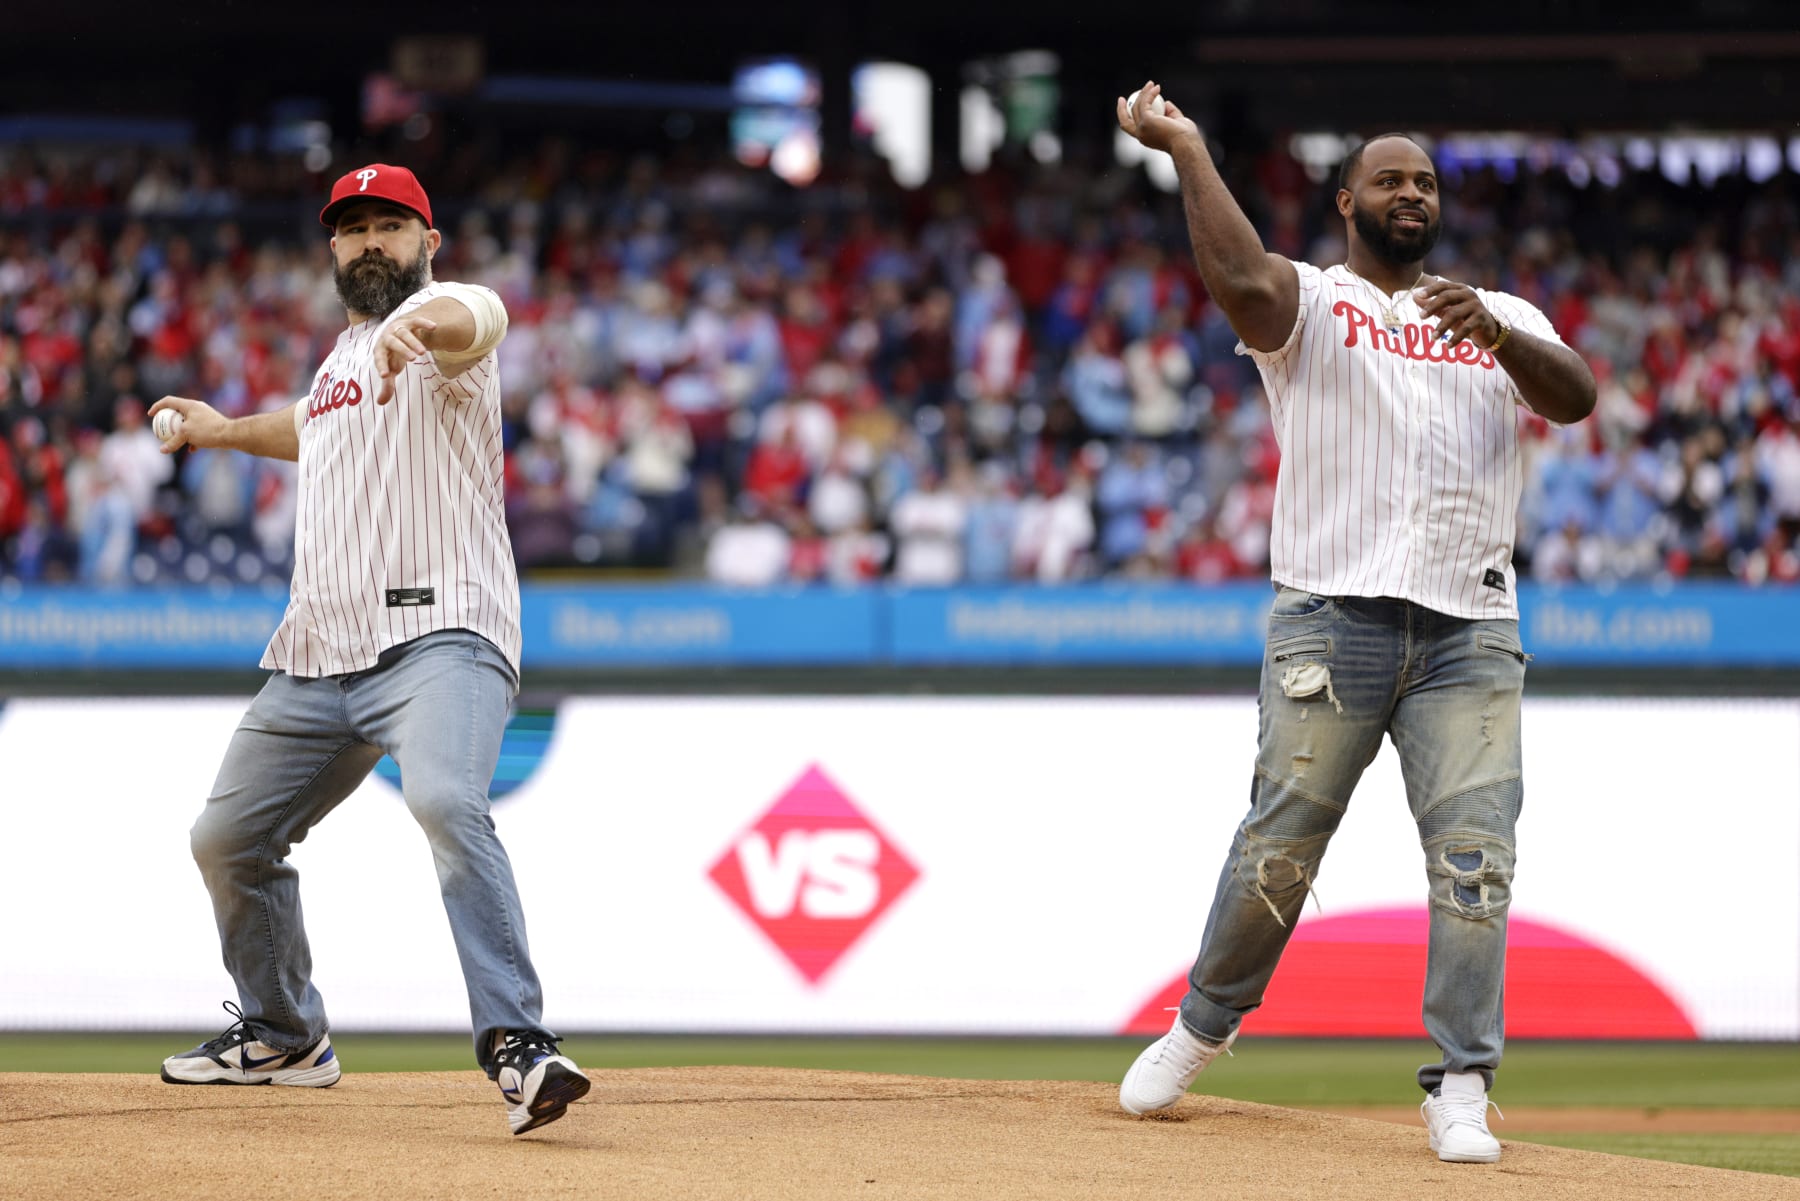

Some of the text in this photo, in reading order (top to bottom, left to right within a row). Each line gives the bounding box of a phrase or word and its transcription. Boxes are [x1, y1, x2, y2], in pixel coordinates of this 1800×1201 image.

[356, 169, 378, 192] P
[1333, 300, 1496, 370] Phillies
[737, 829, 881, 918] VS
